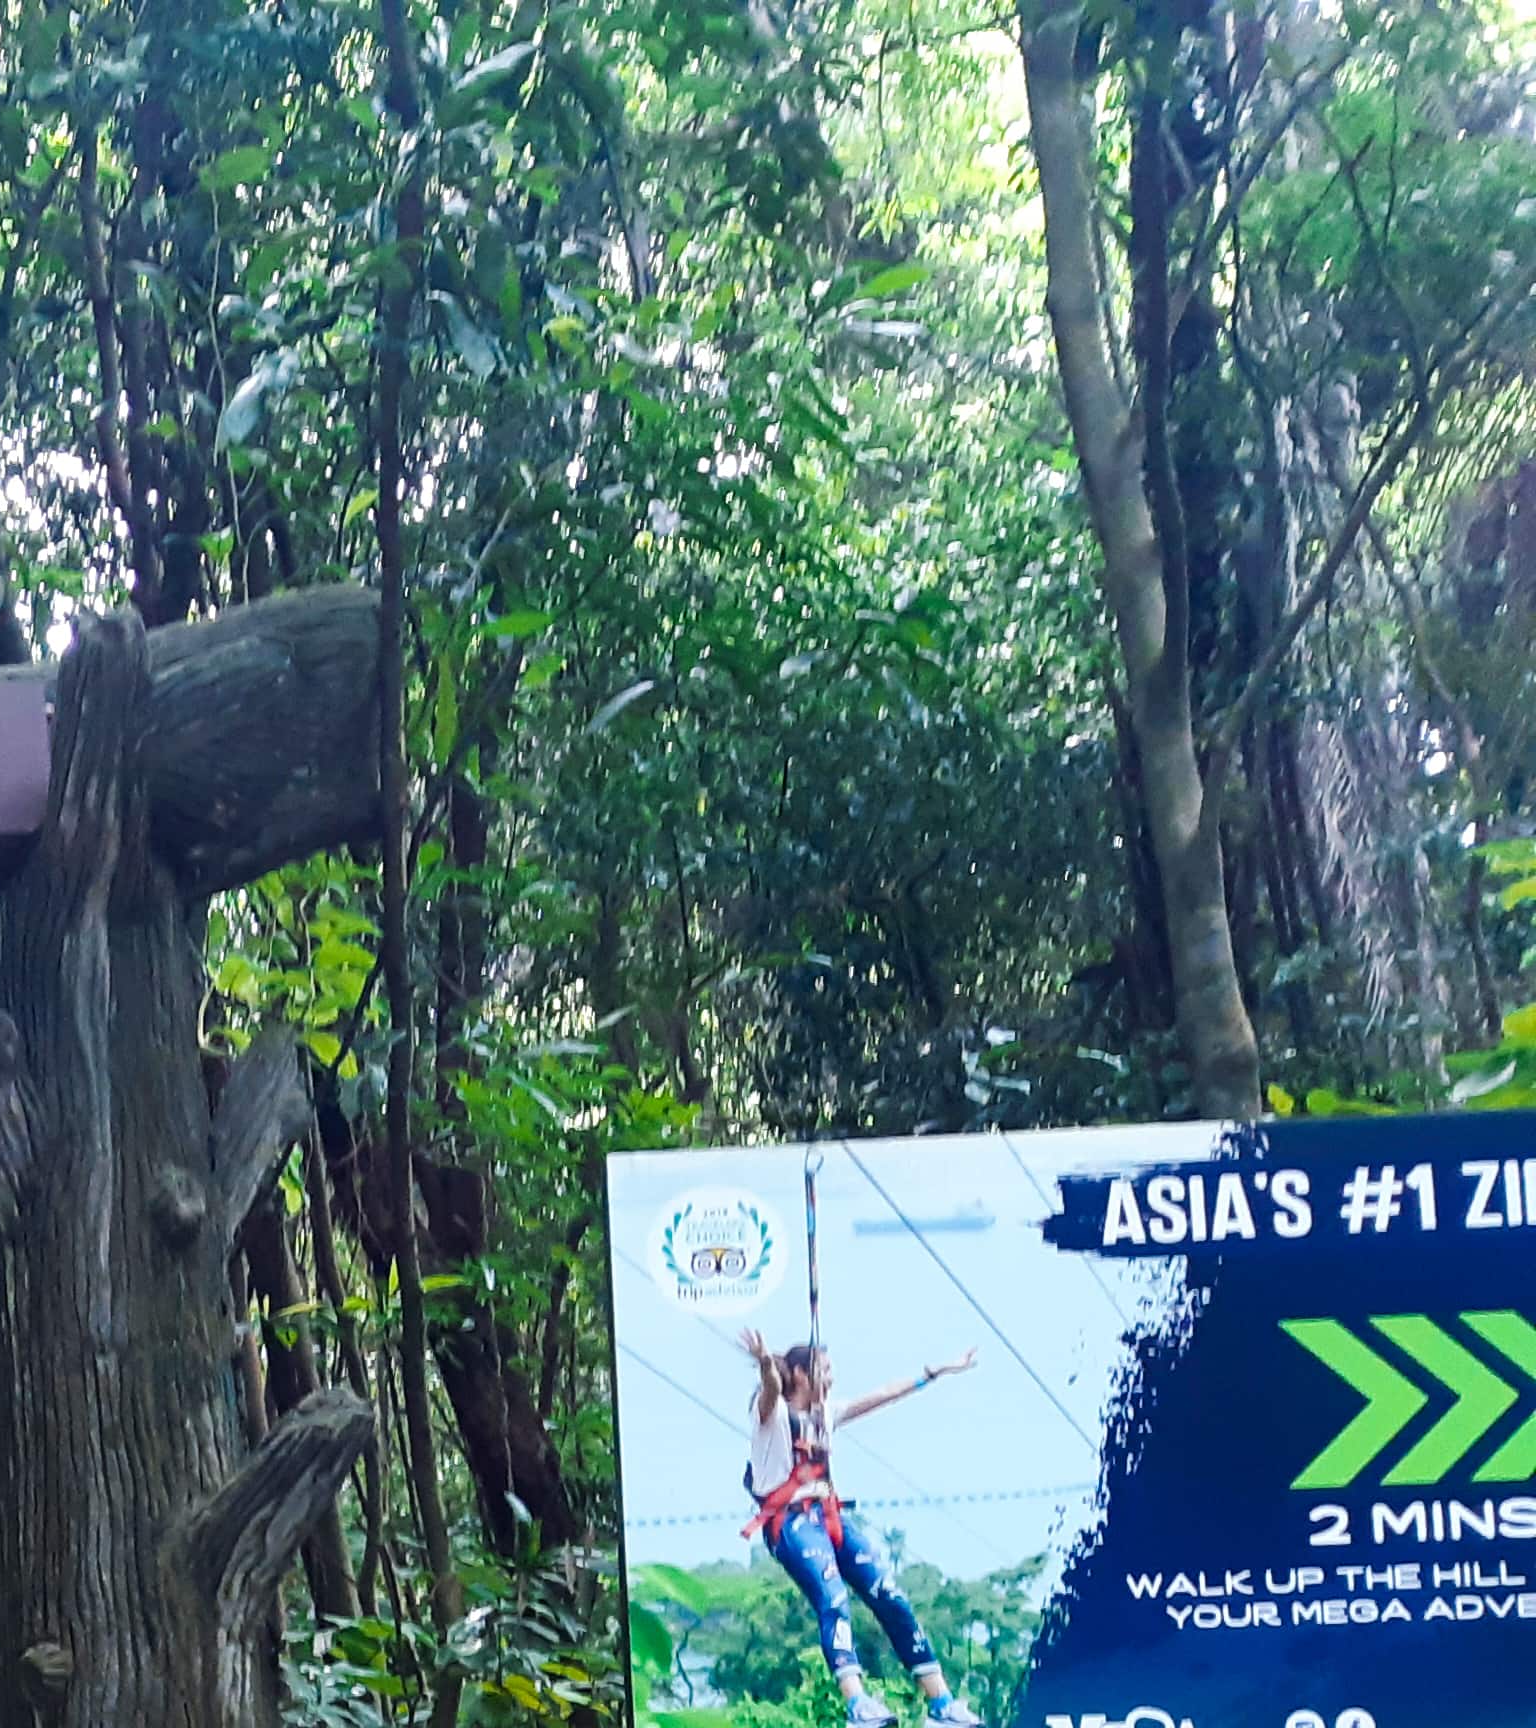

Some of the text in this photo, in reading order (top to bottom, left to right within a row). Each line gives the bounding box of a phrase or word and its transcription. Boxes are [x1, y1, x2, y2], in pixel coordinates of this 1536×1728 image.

[1102, 1168, 1313, 1246] ASIA'S
[1340, 1162, 1437, 1234] #1
[1309, 1496, 1536, 1546] 2 MINS
[1127, 1559, 1526, 1600] WALK UP THE HILL
[1166, 1592, 1536, 1630] YOUR MEGA ADVE
